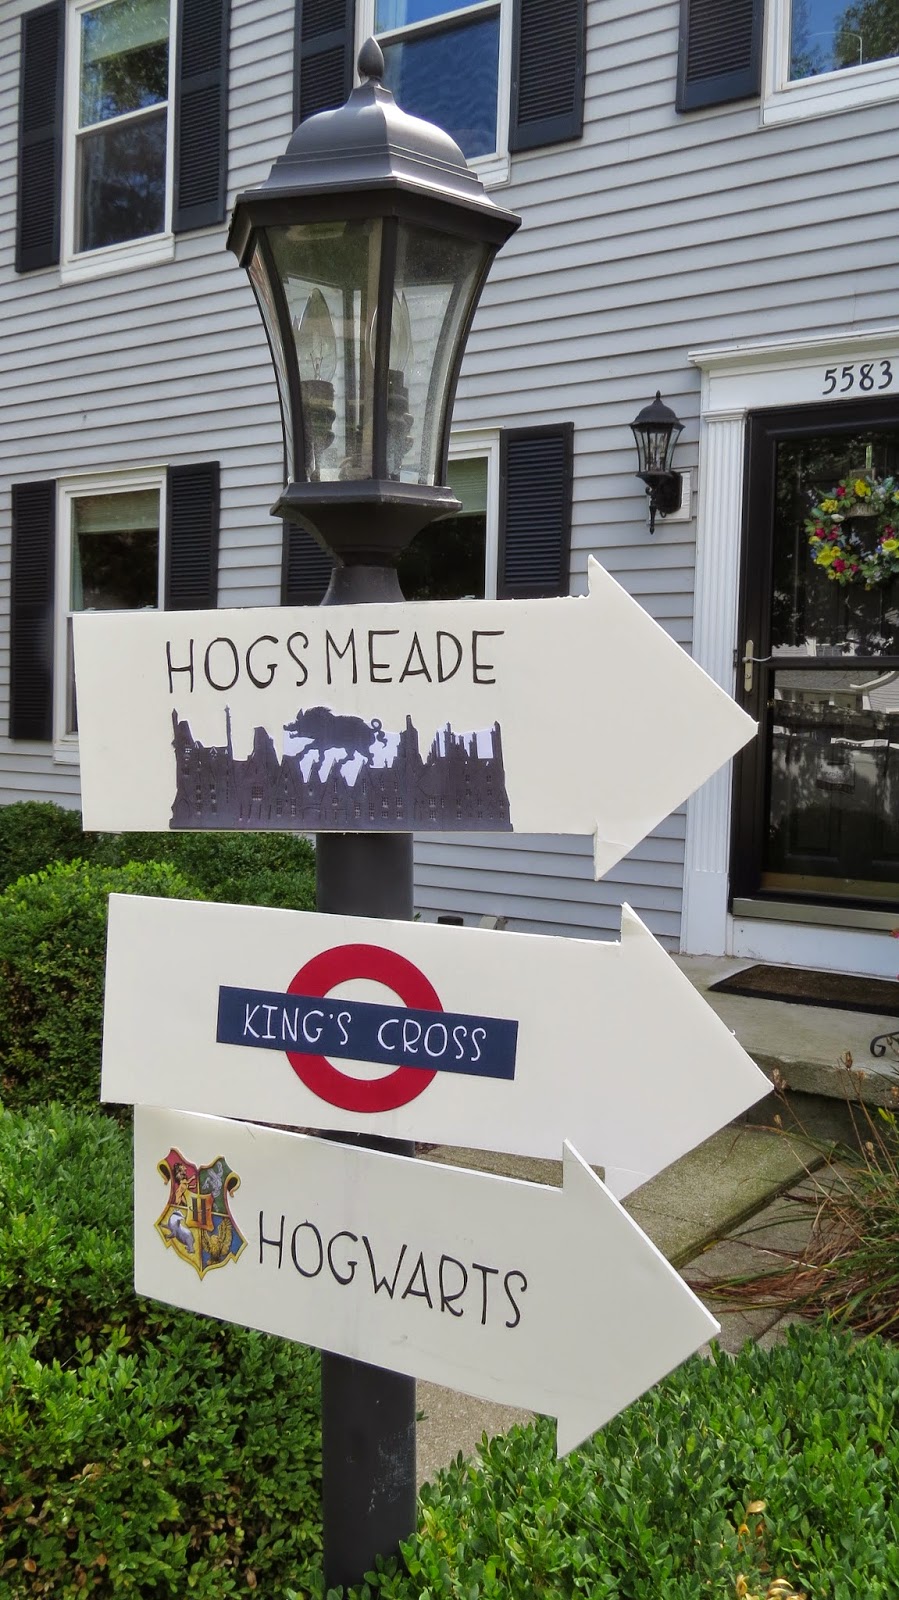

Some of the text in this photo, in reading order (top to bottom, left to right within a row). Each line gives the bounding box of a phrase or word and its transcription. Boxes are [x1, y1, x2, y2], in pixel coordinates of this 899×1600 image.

[822, 360, 893, 395] 5583
[166, 628, 505, 694] HOGSMEADE
[243, 1003, 487, 1062] KING'S CROSS
[258, 1210, 528, 1329] HOGWARTS
